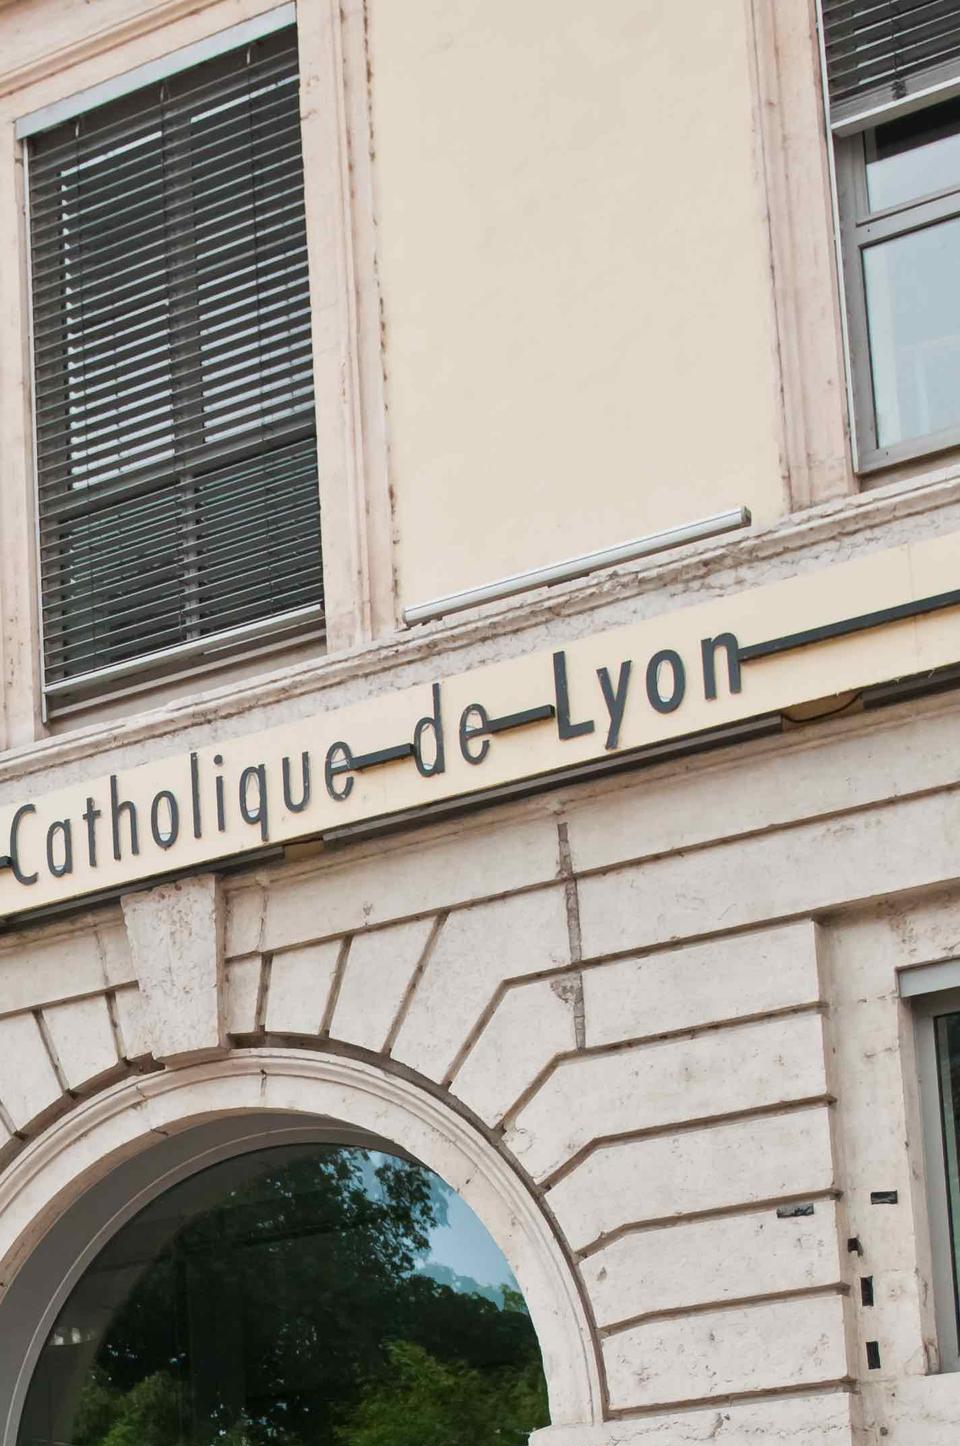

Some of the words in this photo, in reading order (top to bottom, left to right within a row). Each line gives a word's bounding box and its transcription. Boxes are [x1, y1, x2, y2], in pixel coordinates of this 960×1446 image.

[10, 741, 354, 885] Catholique
[414, 683, 490, 777] de
[553, 632, 742, 750] Lyon
